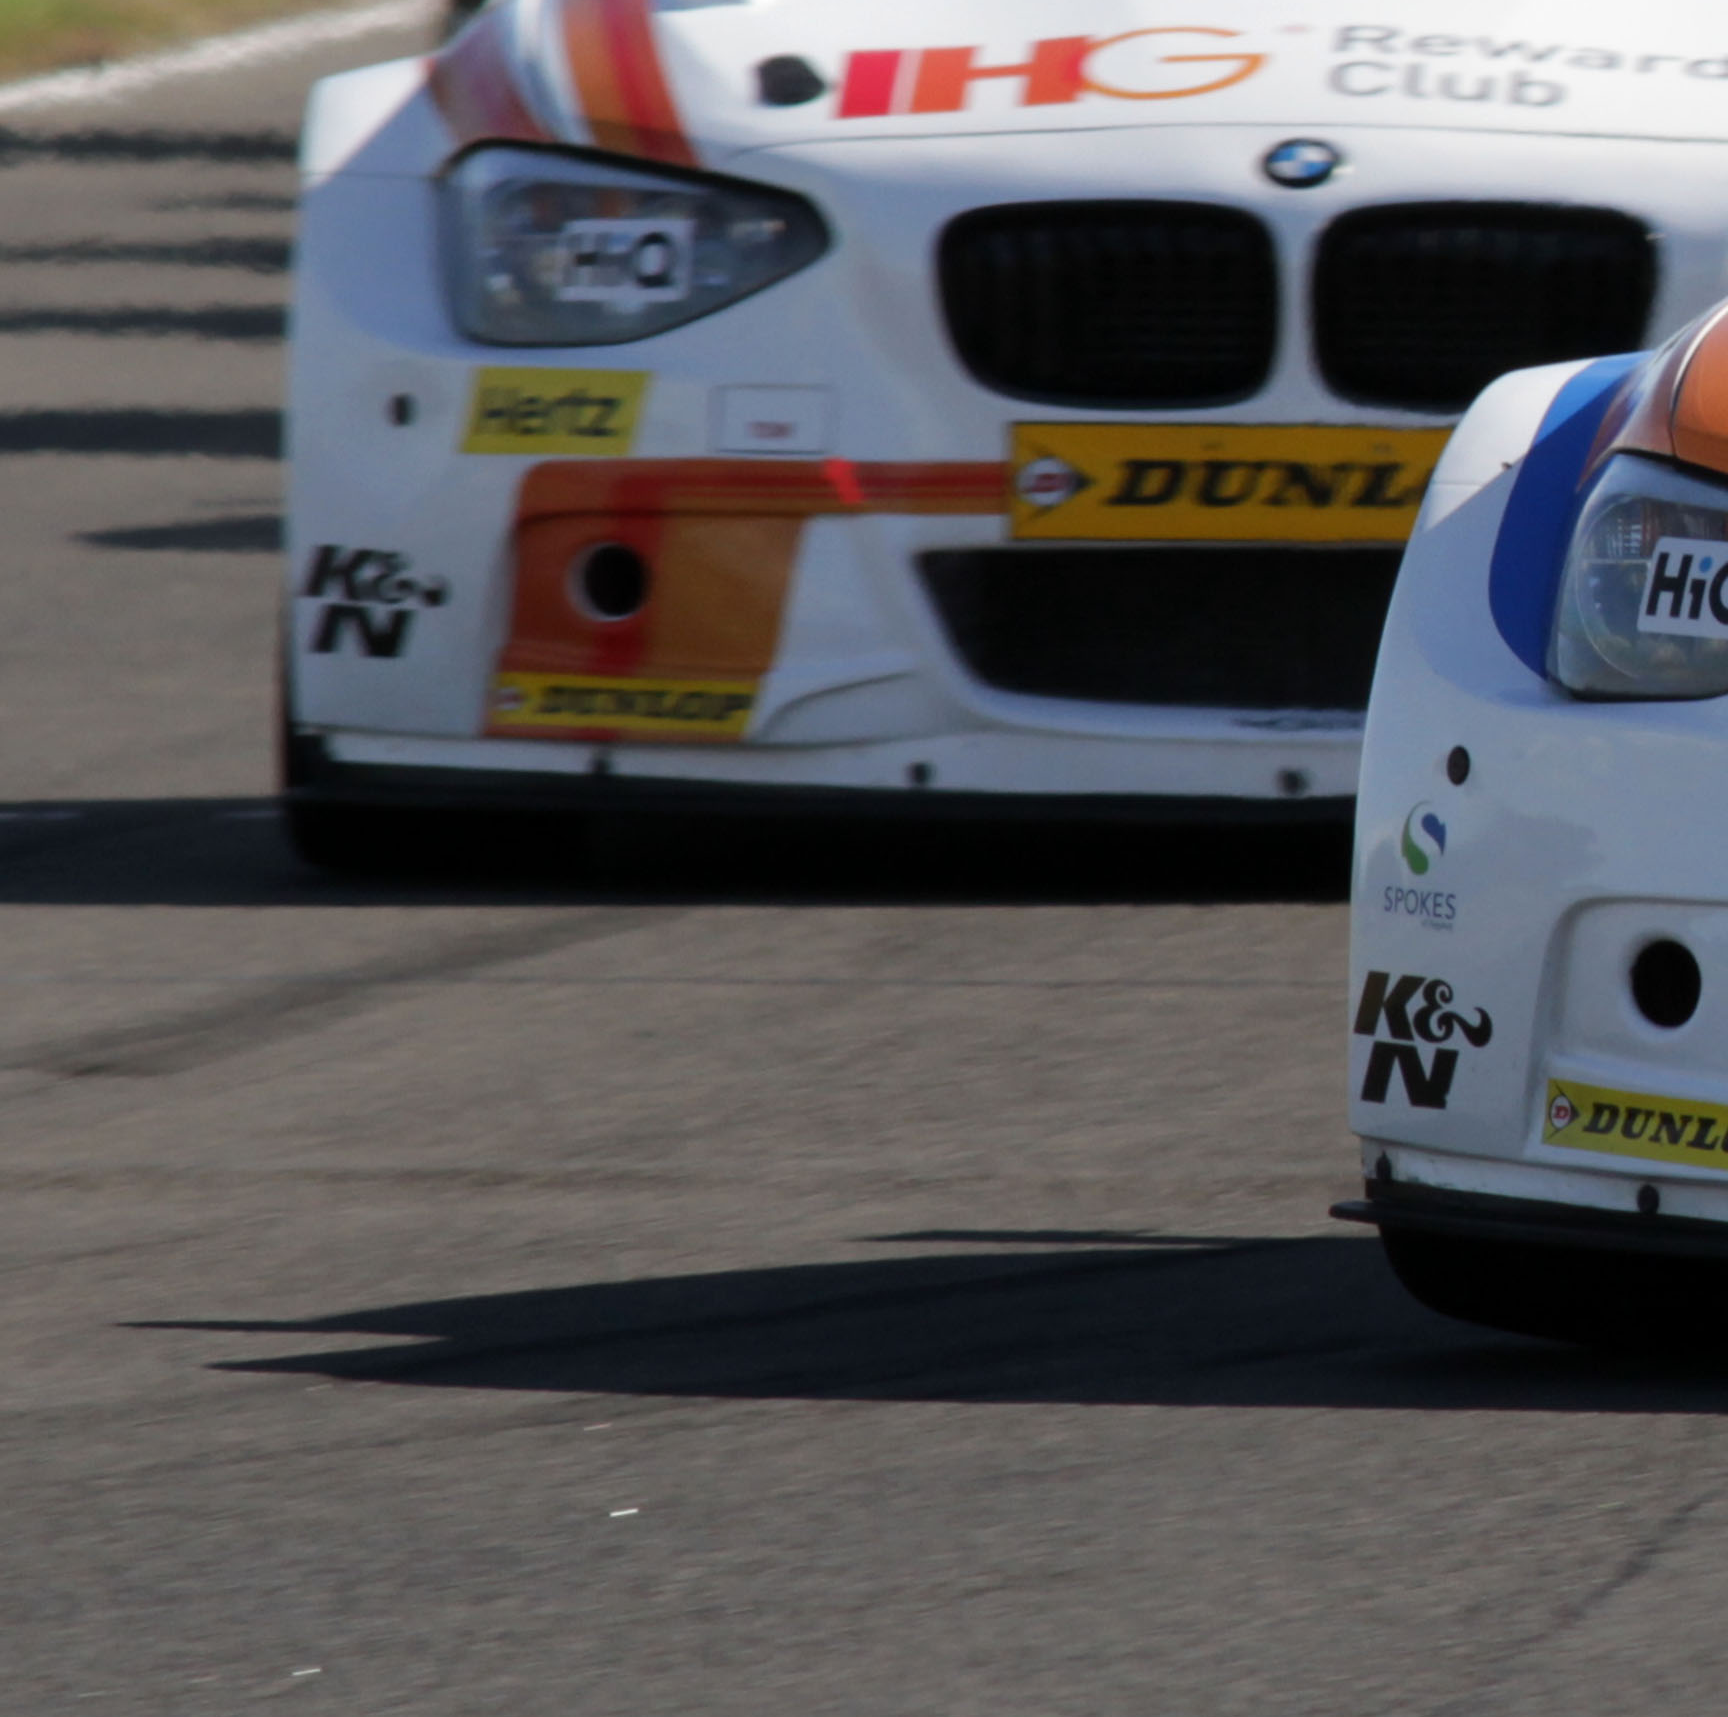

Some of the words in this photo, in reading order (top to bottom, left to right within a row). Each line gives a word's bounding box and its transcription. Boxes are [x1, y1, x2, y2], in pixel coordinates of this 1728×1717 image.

[833, 25, 1268, 119] IHG
[1326, 60, 1569, 107] Club
[480, 393, 622, 437] Hertz
[1105, 459, 1434, 508] DUNL
[1384, 886, 1456, 920] SPOKES
